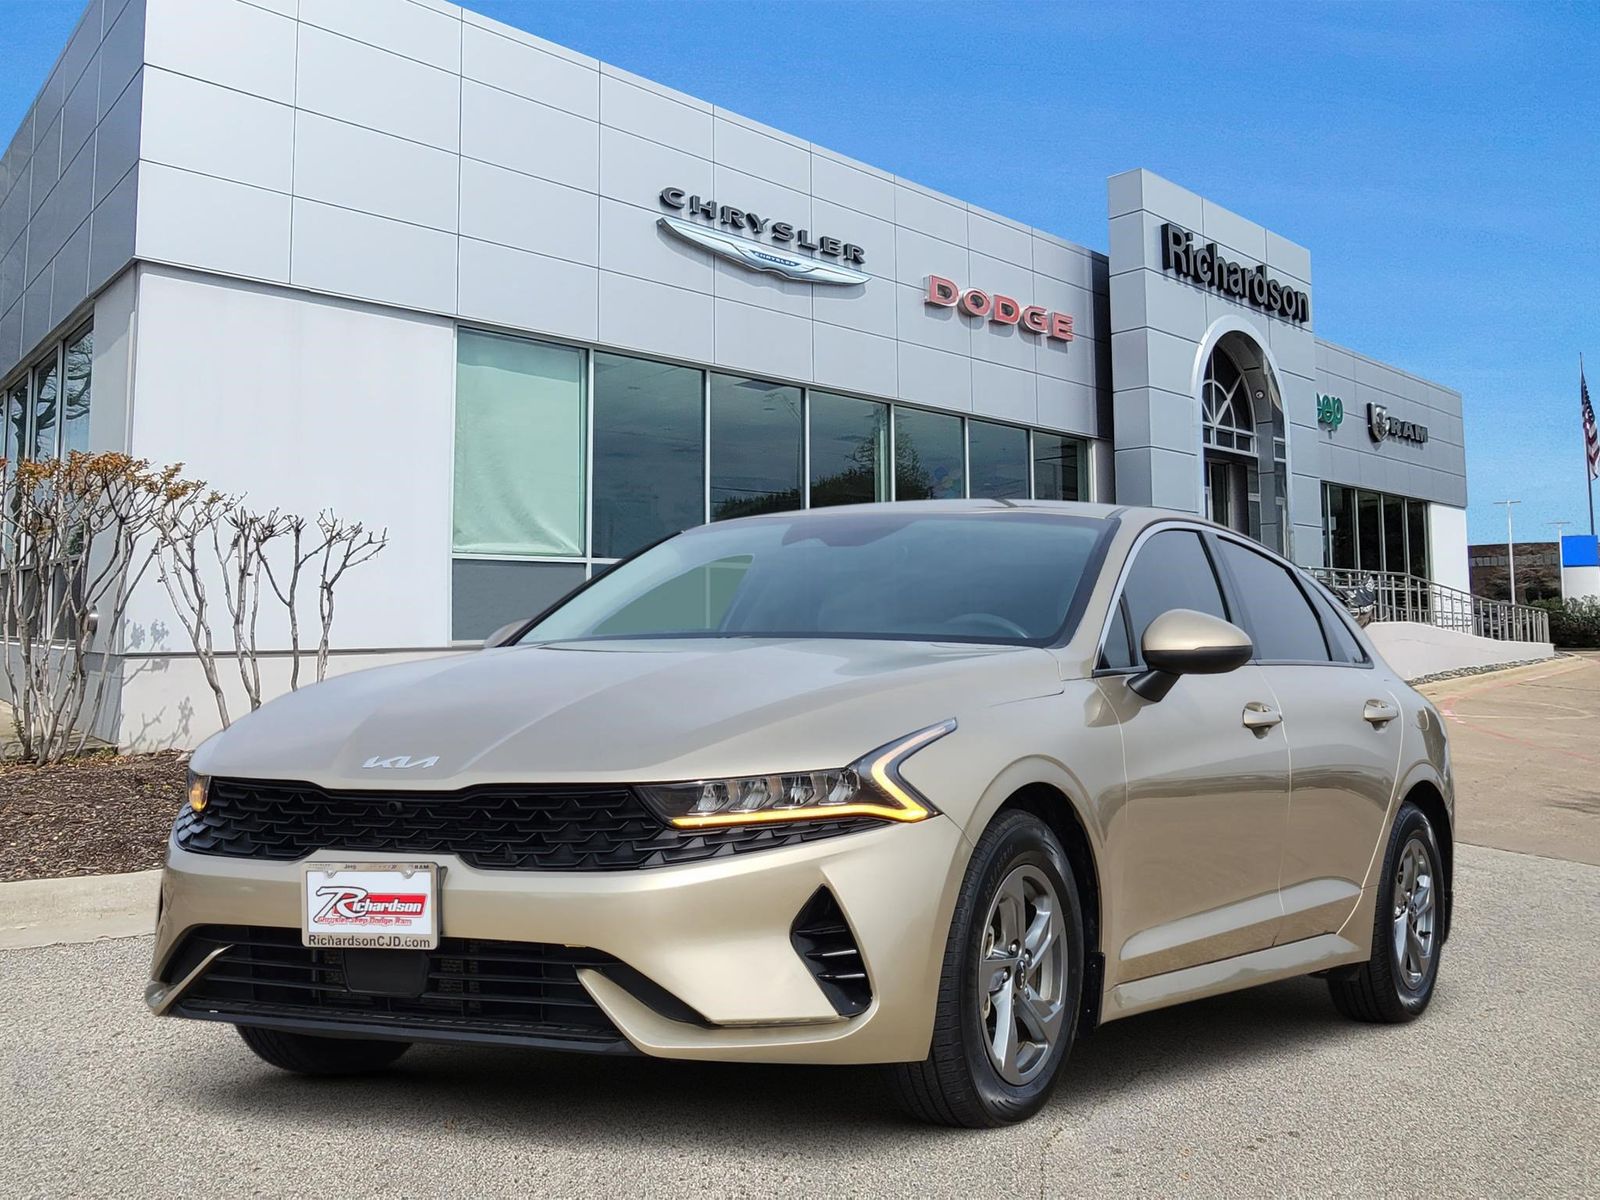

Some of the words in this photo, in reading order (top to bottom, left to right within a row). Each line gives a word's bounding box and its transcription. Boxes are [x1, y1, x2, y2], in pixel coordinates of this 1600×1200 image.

[659, 186, 866, 264] CHRYSLER
[1161, 222, 1310, 323] Richardson
[923, 274, 1074, 342] DODGE
[1385, 416, 1429, 443] RAM
[362, 755, 440, 769] KIA
[313, 886, 422, 923] Richardson
[308, 934, 431, 948] RichardsonCJD.com
